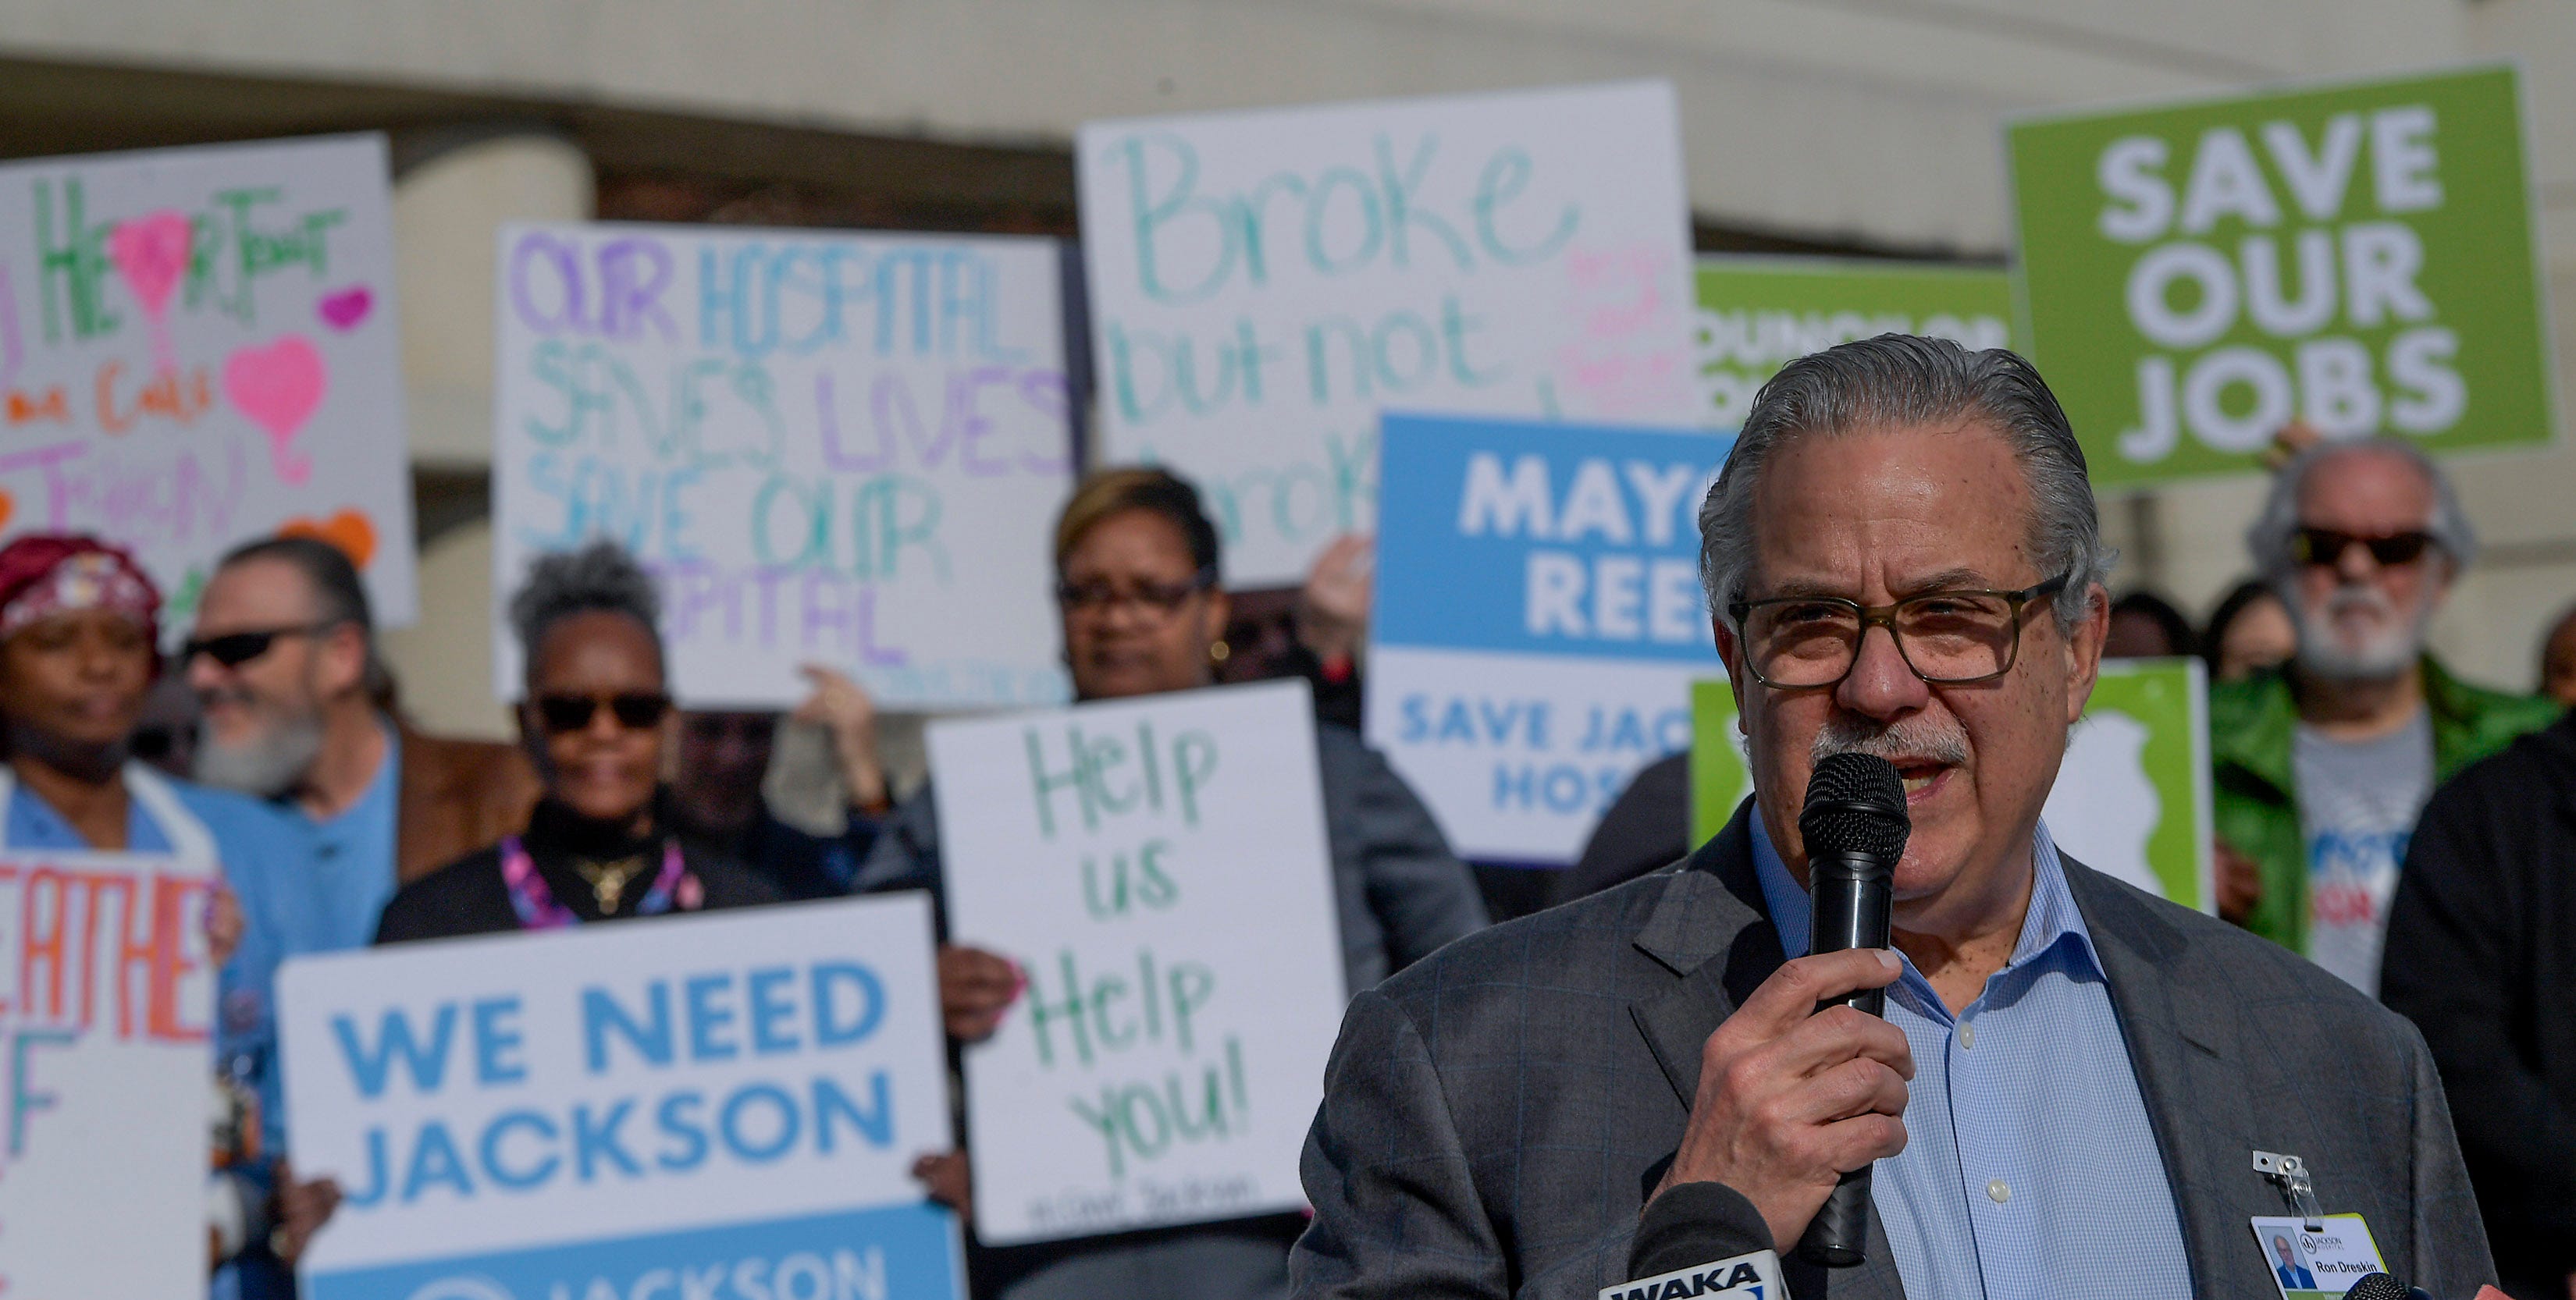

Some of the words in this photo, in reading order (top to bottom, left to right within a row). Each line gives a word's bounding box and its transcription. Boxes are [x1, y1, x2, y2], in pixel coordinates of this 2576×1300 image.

[2097, 105, 2444, 243] SAVE
[510, 233, 681, 343] OUR
[699, 242, 1029, 363] HOSPITAL
[2129, 224, 2432, 347] OUR
[521, 341, 785, 468] SAVES
[816, 367, 1071, 477] LIVES
[1106, 317, 1284, 424] but
[1308, 295, 1510, 404] not
[2119, 328, 2467, 460] JOBS
[511, 454, 705, 559] SAVE
[752, 474, 952, 581] OUR
[1457, 452, 1705, 549] MAY
[1525, 550, 1711, 641] REE
[1023, 720, 1219, 840] Help
[1397, 692, 1551, 751] SAVE
[1081, 837, 1179, 921] us
[330, 996, 528, 1099] WE
[580, 961, 889, 1074] NEED
[1021, 947, 1215, 1068] Help
[345, 1071, 895, 1208] JACKSON
[2315, 1261, 2338, 1273] Ron
[2337, 1261, 2378, 1273] Dreskin
